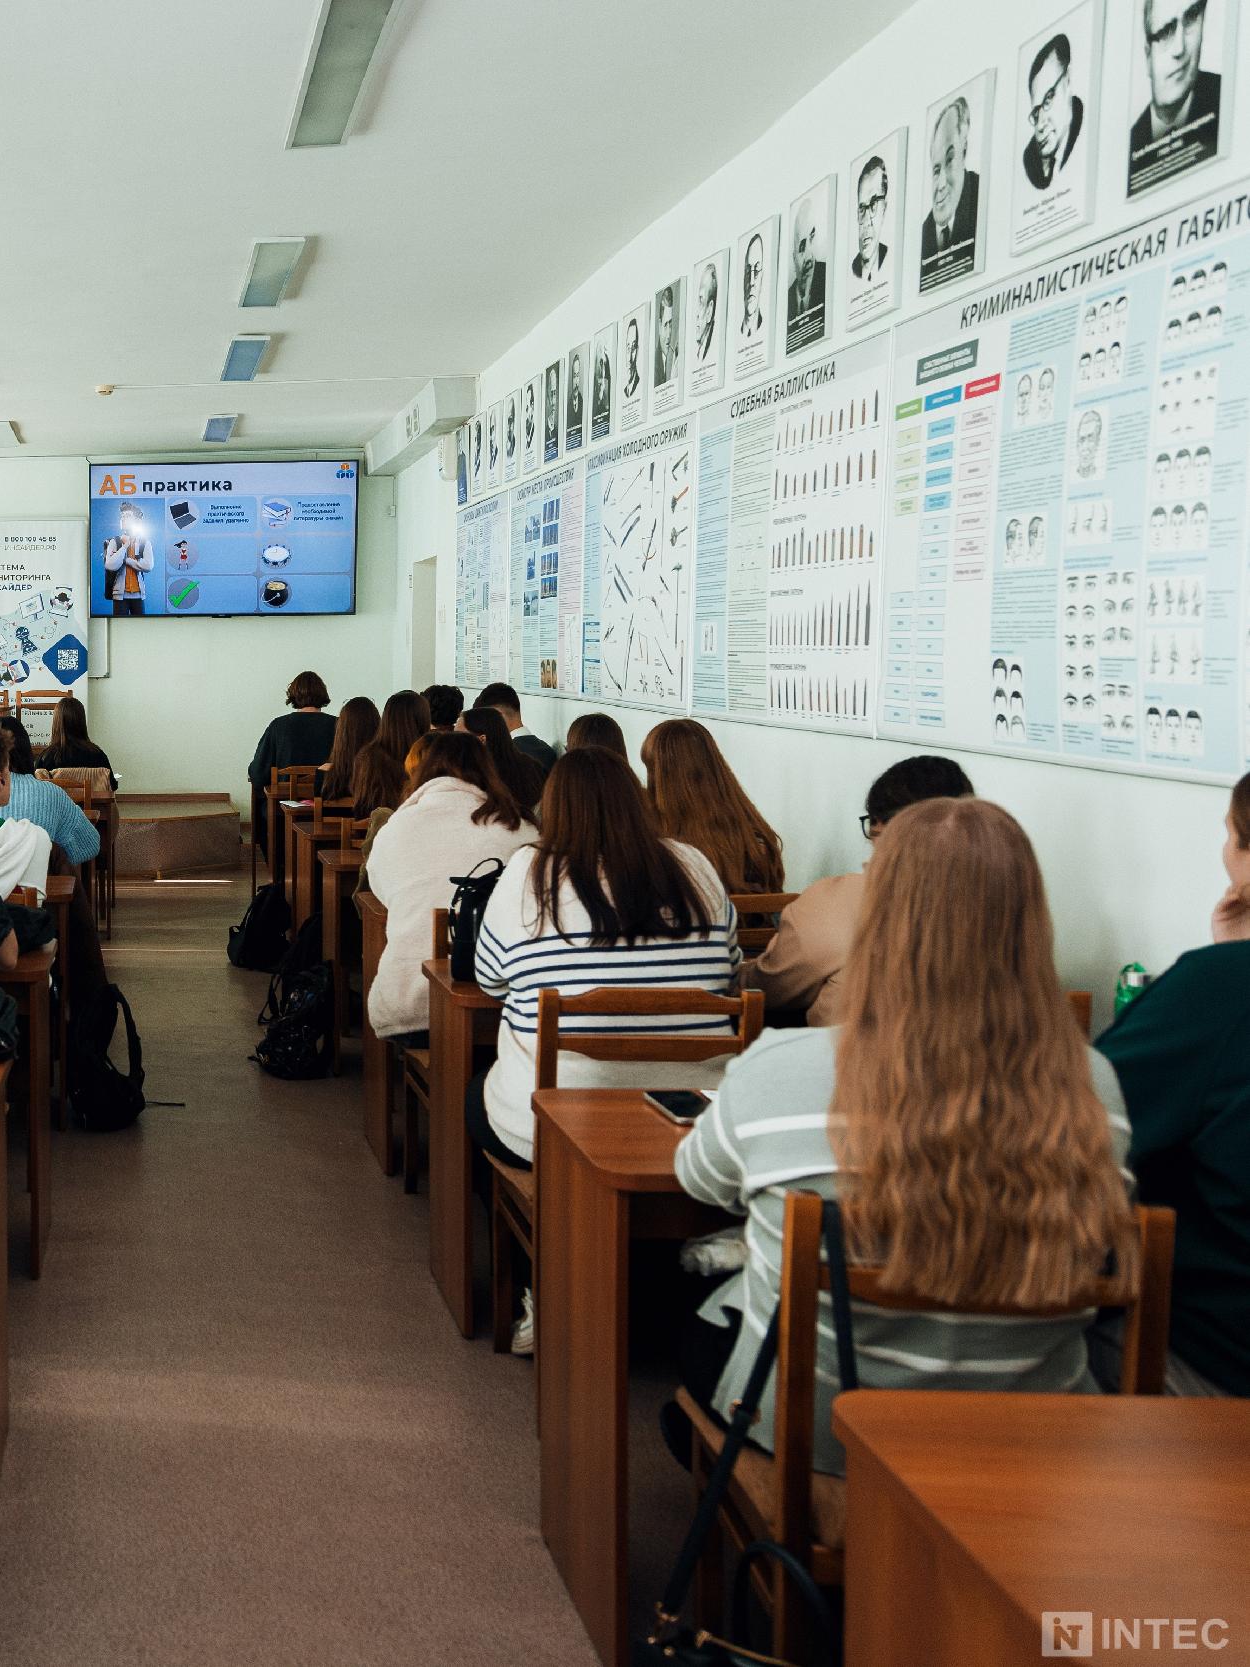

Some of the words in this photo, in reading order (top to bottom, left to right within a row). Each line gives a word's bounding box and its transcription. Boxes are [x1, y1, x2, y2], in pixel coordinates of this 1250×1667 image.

[960, 227, 1168, 329] КРИМИНАЛИСТИЧЕСКАЯ
[730, 386, 773, 419] СУДЕБНАЯ
[773, 360, 835, 403] БАЛЛИСТИКА
[622, 433, 659, 457] ХОЛОДНОГО
[660, 422, 688, 446] ОРУЖИЯ
[99, 474, 137, 496] АБ
[142, 480, 232, 495] практика
